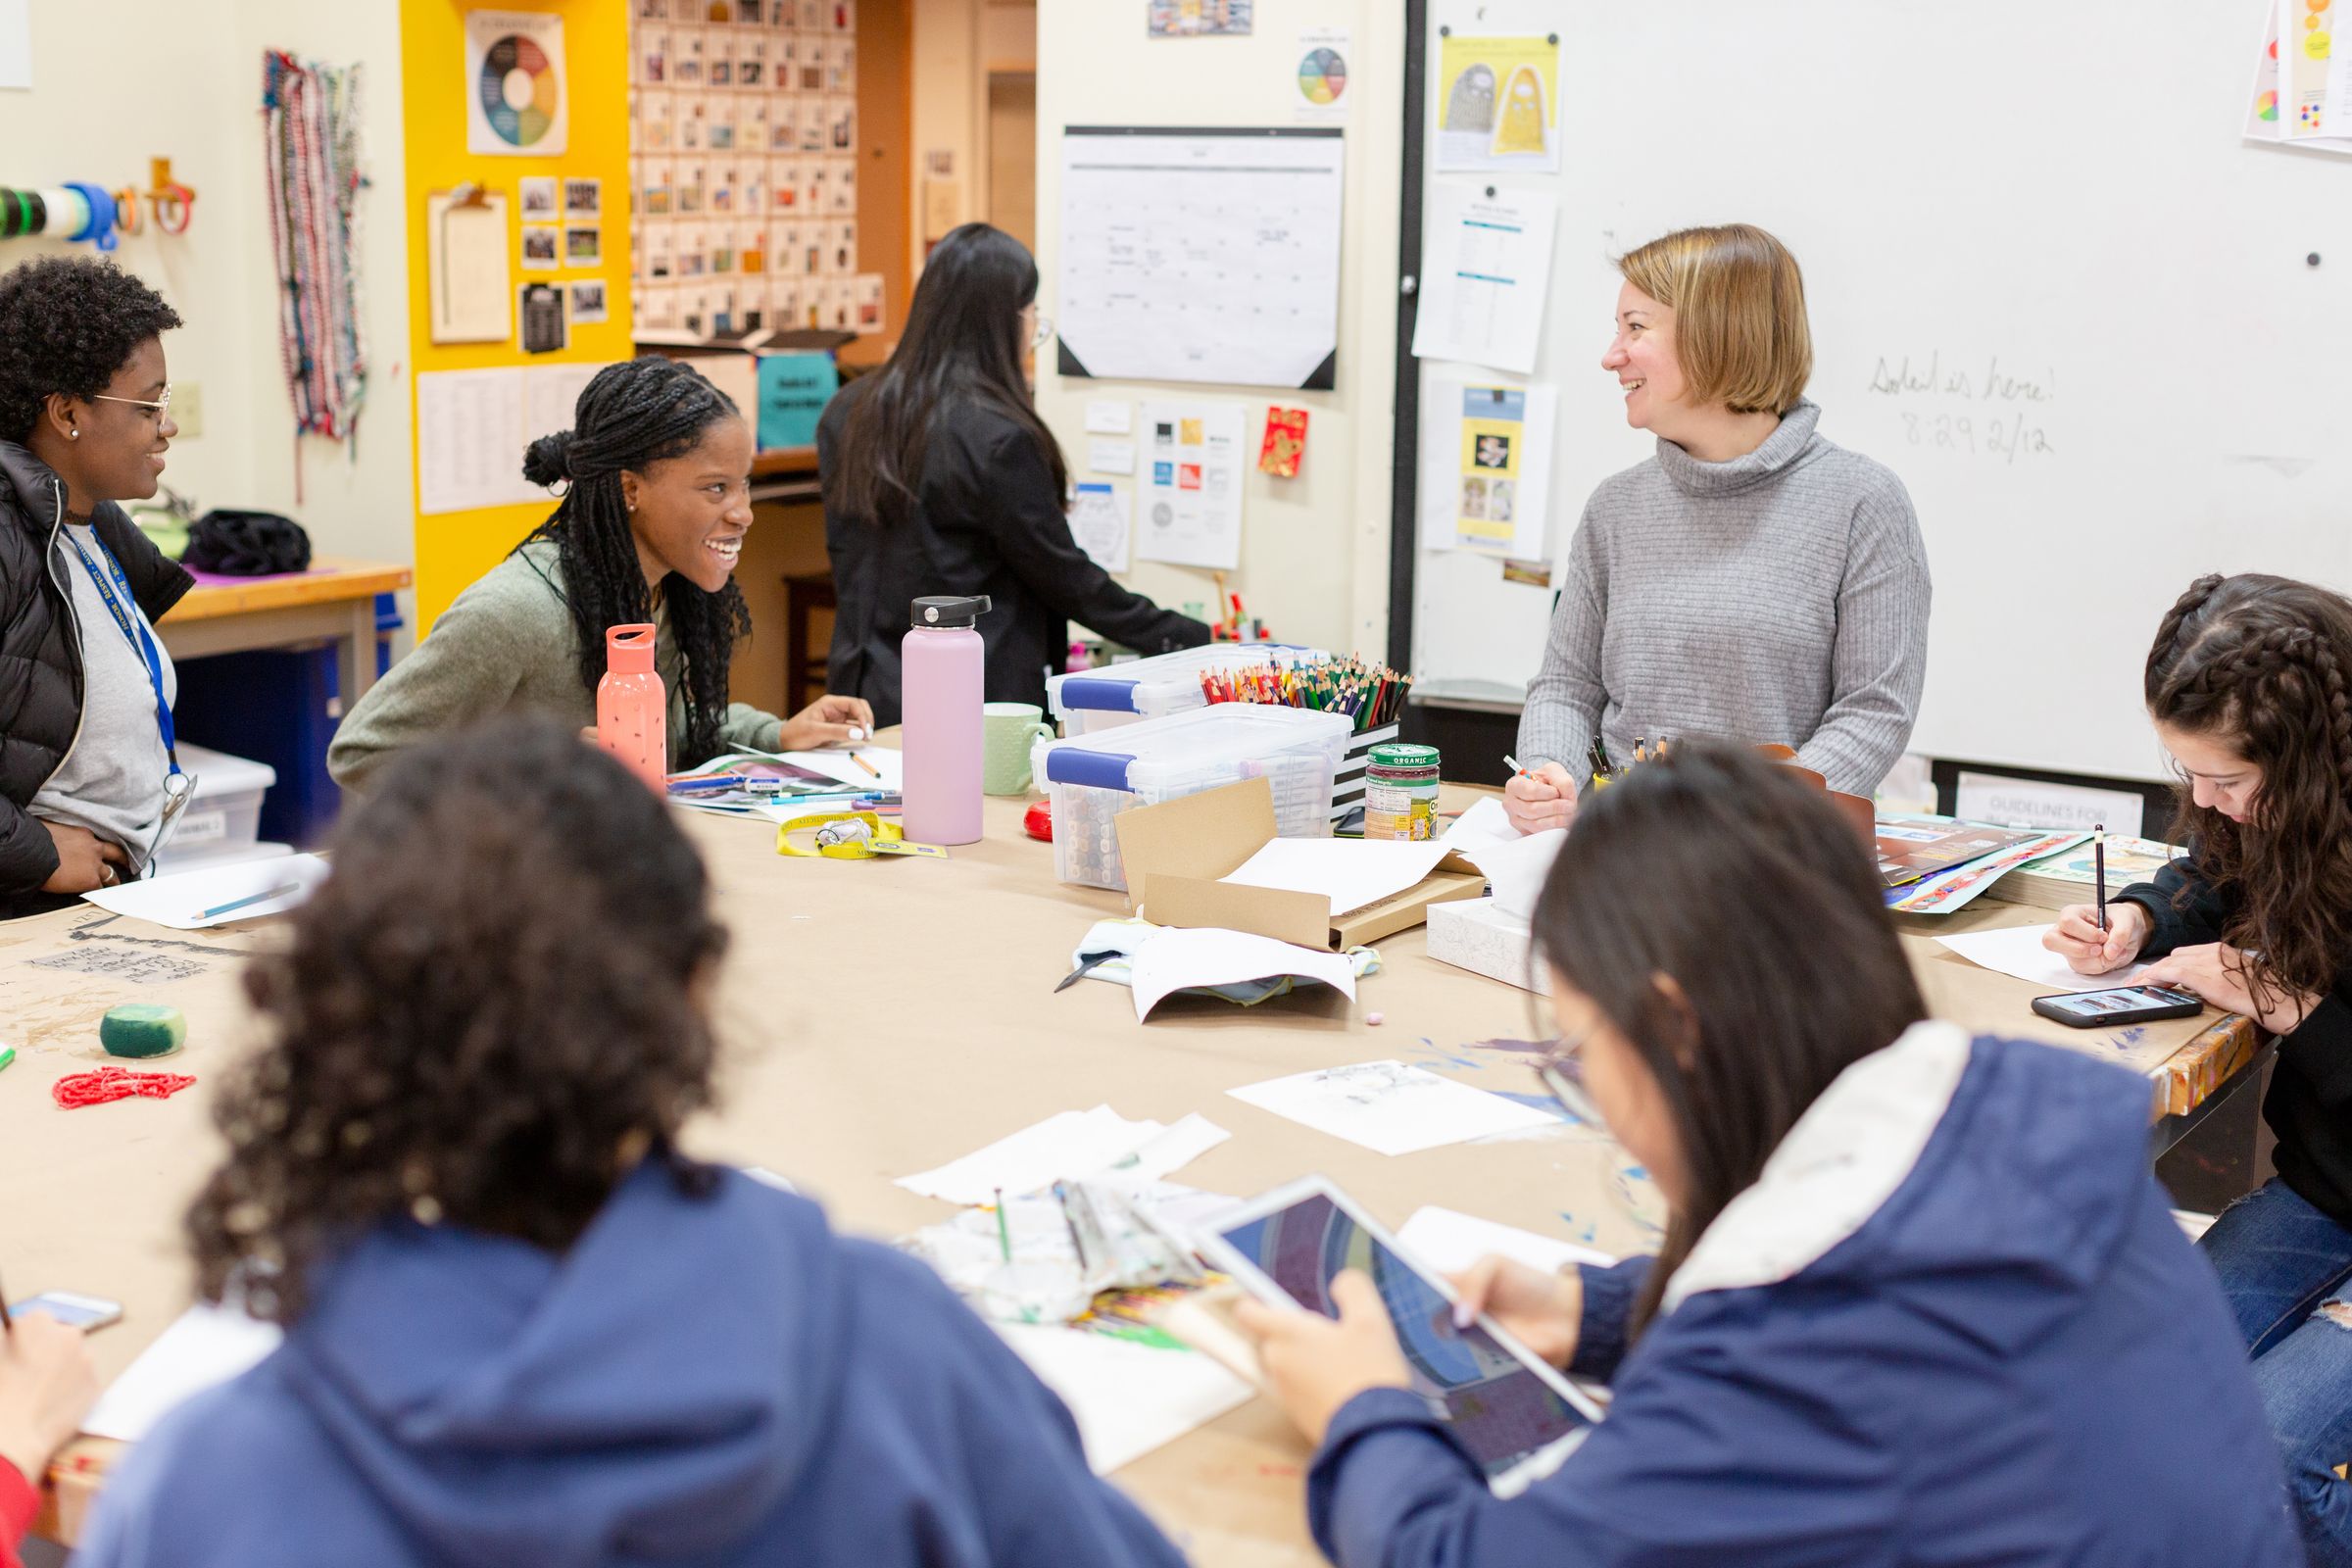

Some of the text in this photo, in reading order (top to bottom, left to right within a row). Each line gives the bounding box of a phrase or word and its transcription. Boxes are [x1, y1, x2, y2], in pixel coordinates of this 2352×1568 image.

[1868, 349, 1938, 395] Soleil
[1901, 412, 2055, 466] 8:29 2/12
[93, 570, 112, 599] RESPECT
[112, 603, 129, 630] HONOR
[1989, 795, 2075, 819] GUIDELINES
[2078, 808, 2107, 823] FOR
